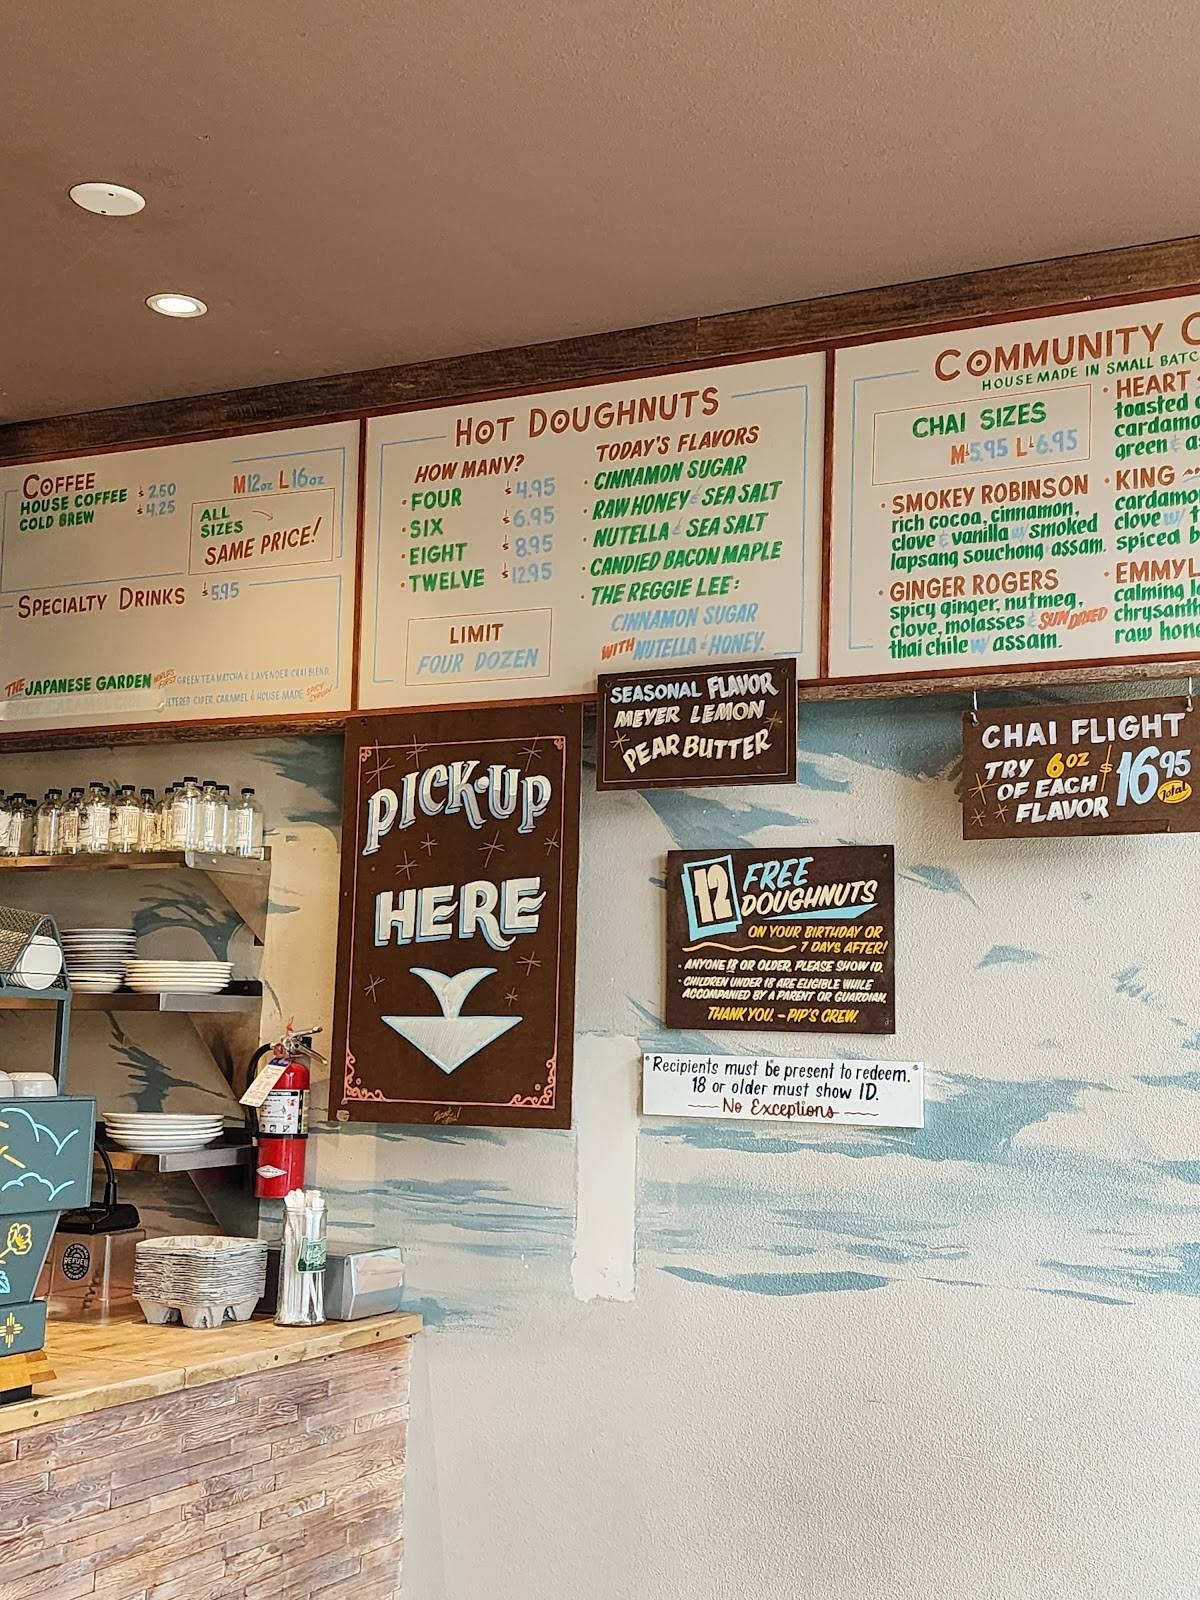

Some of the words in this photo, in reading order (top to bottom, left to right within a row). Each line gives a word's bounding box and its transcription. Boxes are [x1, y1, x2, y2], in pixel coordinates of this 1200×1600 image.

[934, 322, 1164, 382] COMMUNITY
[1106, 357, 1154, 374] SMALL
[1116, 370, 1192, 400] HEART
[455, 417, 515, 447] HOT
[528, 387, 719, 438] DOUGHNUTS
[1114, 392, 1189, 419] toasted
[912, 412, 965, 438] CHAI
[980, 401, 1047, 431] SIZES
[596, 436, 670, 462] TODAY'S
[678, 426, 760, 452] FLAVORS
[1115, 438, 1168, 461] green
[414, 462, 458, 484] HOW
[461, 454, 524, 478] MANY?
[594, 462, 684, 490] CINNAMON
[687, 455, 748, 478] SUGAR
[1116, 465, 1175, 490] KING
[23, 473, 96, 499] COFFEE
[892, 487, 975, 514] SMOKEY
[982, 474, 1089, 505] ROBINSON
[20, 495, 68, 515] HOUSE
[74, 488, 128, 508] COFFEE
[411, 488, 462, 511] FOUR
[592, 496, 630, 520] RAW
[630, 489, 691, 516] HONEY
[701, 486, 738, 506] SEA
[738, 480, 784, 503] SALT
[20, 517, 53, 532] COLD
[58, 510, 94, 526] BREW
[200, 507, 230, 522] ALL
[892, 512, 924, 534] rich
[990, 501, 1080, 524] cinnamon,
[1114, 511, 1161, 530] clove
[200, 521, 243, 538] SIZES
[410, 518, 444, 538] SIX
[592, 522, 670, 548] NUTELLA
[686, 517, 721, 538] SEA
[723, 512, 769, 534] SALT
[892, 531, 936, 551] clove
[952, 524, 1009, 546] vanilla
[1028, 513, 1098, 538] smoked
[1116, 528, 1180, 553] spiced
[205, 538, 256, 566] SAME
[261, 517, 322, 555] PRICE!
[409, 542, 468, 565] EIGHT
[590, 551, 660, 576] CANDIED
[663, 546, 721, 570] BACON
[721, 540, 784, 564] MAPLE
[890, 550, 958, 573] lapsang
[963, 544, 1044, 566] souchong
[409, 568, 484, 592] TWELVE
[592, 584, 626, 606] THE
[627, 578, 692, 602] REGGIE
[890, 577, 964, 602] GINGER
[972, 568, 1060, 598] ROGERS
[1114, 579, 1184, 602] calming
[18, 594, 108, 618] SPECIALTY
[120, 587, 185, 610] DRINKS
[890, 602, 936, 622] spicy
[940, 598, 1000, 620] ginger,
[610, 607, 699, 632] CINNAMON
[704, 603, 758, 625] SUGAR
[945, 613, 1026, 635] molasses
[450, 623, 504, 644] LIMIT
[888, 638, 922, 660] thai
[926, 635, 969, 656] chile
[992, 633, 1062, 652] assam.
[1114, 626, 1152, 644] raw
[417, 653, 464, 674] FOUR
[474, 648, 539, 672] DOZEN
[602, 637, 635, 661] WITH
[633, 639, 696, 660] NUTELLA
[5, 678, 25, 697] THE
[25, 677, 92, 696] JAPANESE
[96, 673, 152, 690] GARDEN
[177, 675, 199, 684] GREEN
[201, 674, 216, 683] TEA
[251, 669, 289, 680] LAVENDER
[610, 681, 703, 704] SEASONAL
[707, 672, 779, 700] FLAVOR
[614, 706, 680, 728] MEYER
[690, 700, 765, 724] LEMON
[982, 720, 1057, 750] CHAI
[1072, 712, 1185, 744] FLIGHT
[622, 734, 680, 774] PEAR
[682, 728, 772, 760] BUTTER
[984, 758, 1034, 780] TRY
[997, 781, 1030, 800] OF
[1034, 774, 1098, 798] EACH
[1016, 797, 1110, 823] FLAVOR
[694, 864, 732, 923] 12
[742, 856, 814, 892] FREE
[741, 880, 878, 916] DOUGHNUTS
[374, 876, 548, 952] HERE
[748, 926, 768, 938] ON
[770, 926, 802, 938] YOUR
[804, 926, 862, 938] BIRTHDAY
[864, 926, 883, 938] OR
[800, 941, 809, 952] 7
[811, 942, 842, 953] DAYS
[844, 940, 888, 954] AFTER!
[684, 958, 726, 971] ANYONE
[726, 959, 738, 971] 18
[740, 960, 756, 971] OR
[794, 960, 832, 972] PLEASE
[836, 960, 868, 972] SHOW
[682, 988, 751, 1000] ACCOMPANIED
[776, 990, 813, 1002] PARENT
[683, 976, 728, 988] CHILDREN
[730, 978, 762, 988] UNDER
[764, 978, 774, 988] 18
[796, 978, 840, 990] ELIGIBLE
[843, 978, 874, 990] WHILE
[708, 1007, 748, 1021] THANK
[653, 1056, 718, 1076] Recipients
[725, 1062, 758, 1076] must
[766, 1060, 780, 1076] be
[784, 1062, 835, 1080] present
[840, 1062, 852, 1080] to
[856, 1062, 910, 1082] redeem.
[692, 1077, 706, 1092] 18
[732, 1080, 768, 1094] older
[773, 1084, 809, 1096] must
[816, 1082, 852, 1098] show
[860, 1083, 880, 1100] ID.
[722, 1098, 742, 1113] No
[751, 1099, 840, 1118] Exceptions
